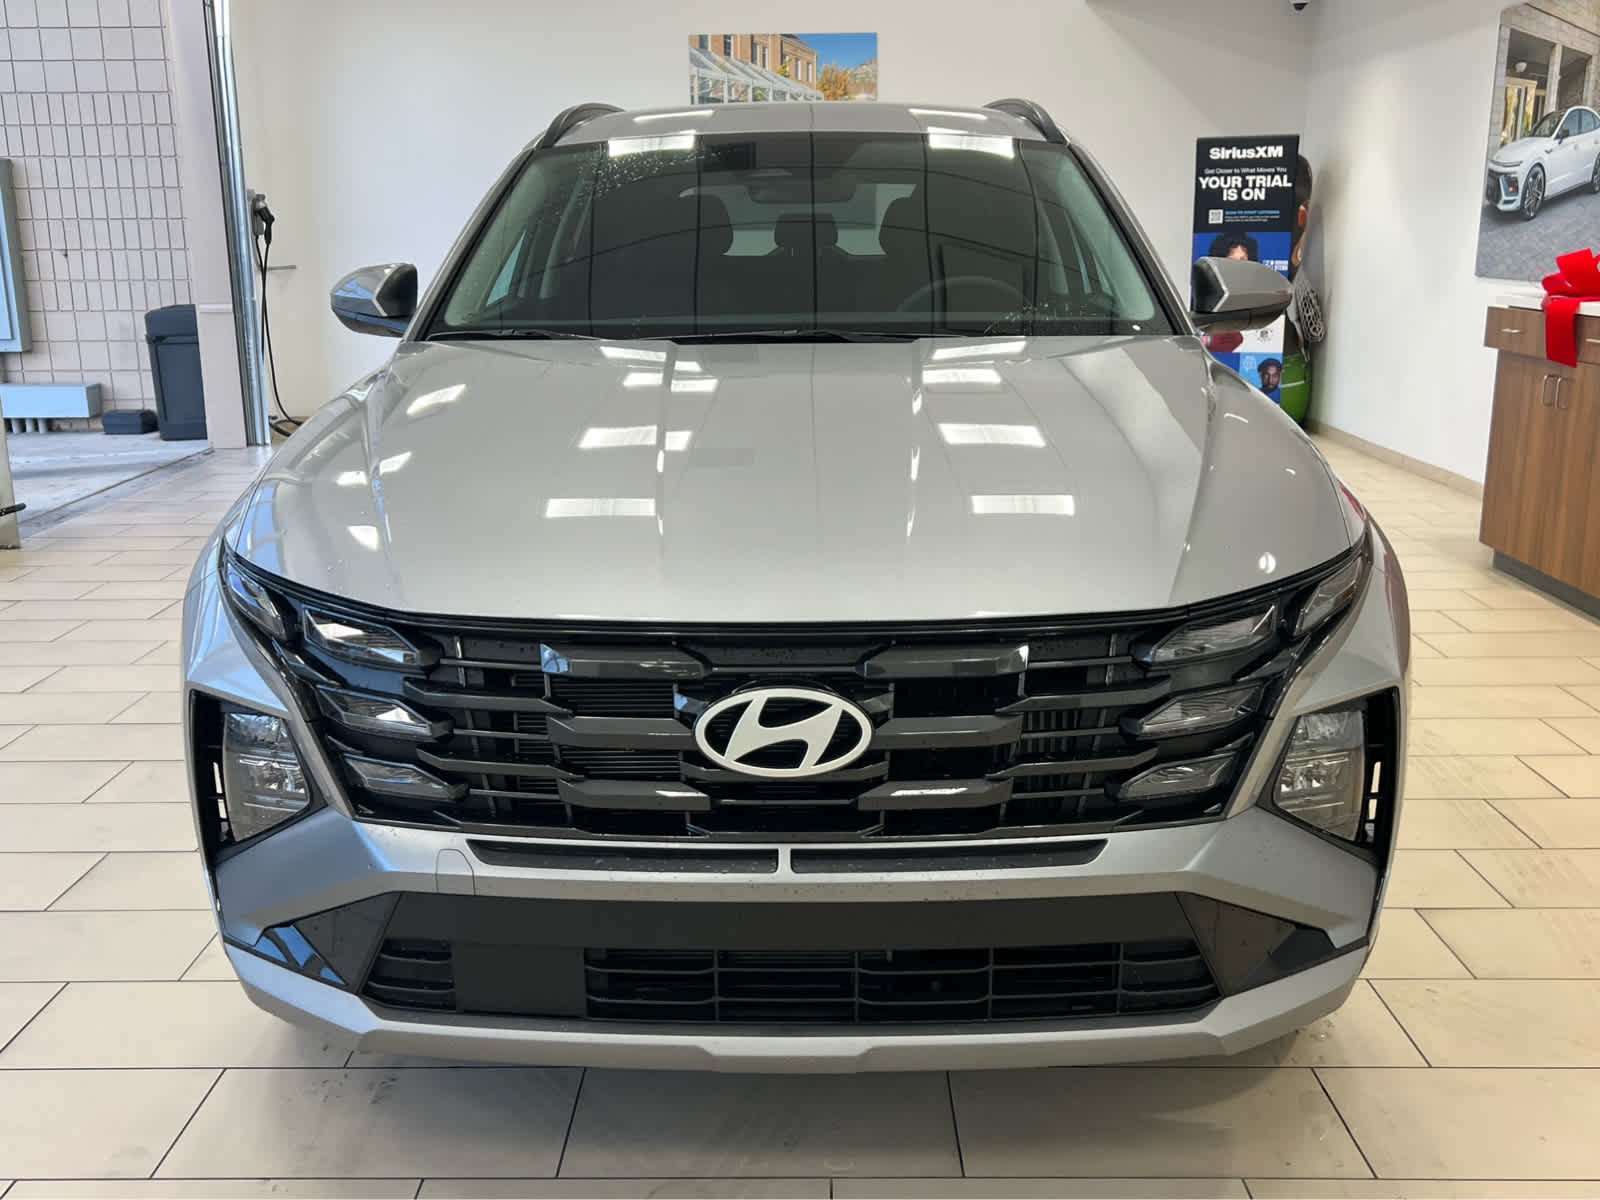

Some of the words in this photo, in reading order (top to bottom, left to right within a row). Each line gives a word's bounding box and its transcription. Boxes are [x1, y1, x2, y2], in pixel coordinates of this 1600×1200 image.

[1209, 145, 1284, 160] SiriusXM
[1199, 176, 1242, 189] YOUR
[1245, 174, 1293, 187] TRIAL
[1223, 188, 1238, 201] IS
[1241, 188, 1266, 201] ON
